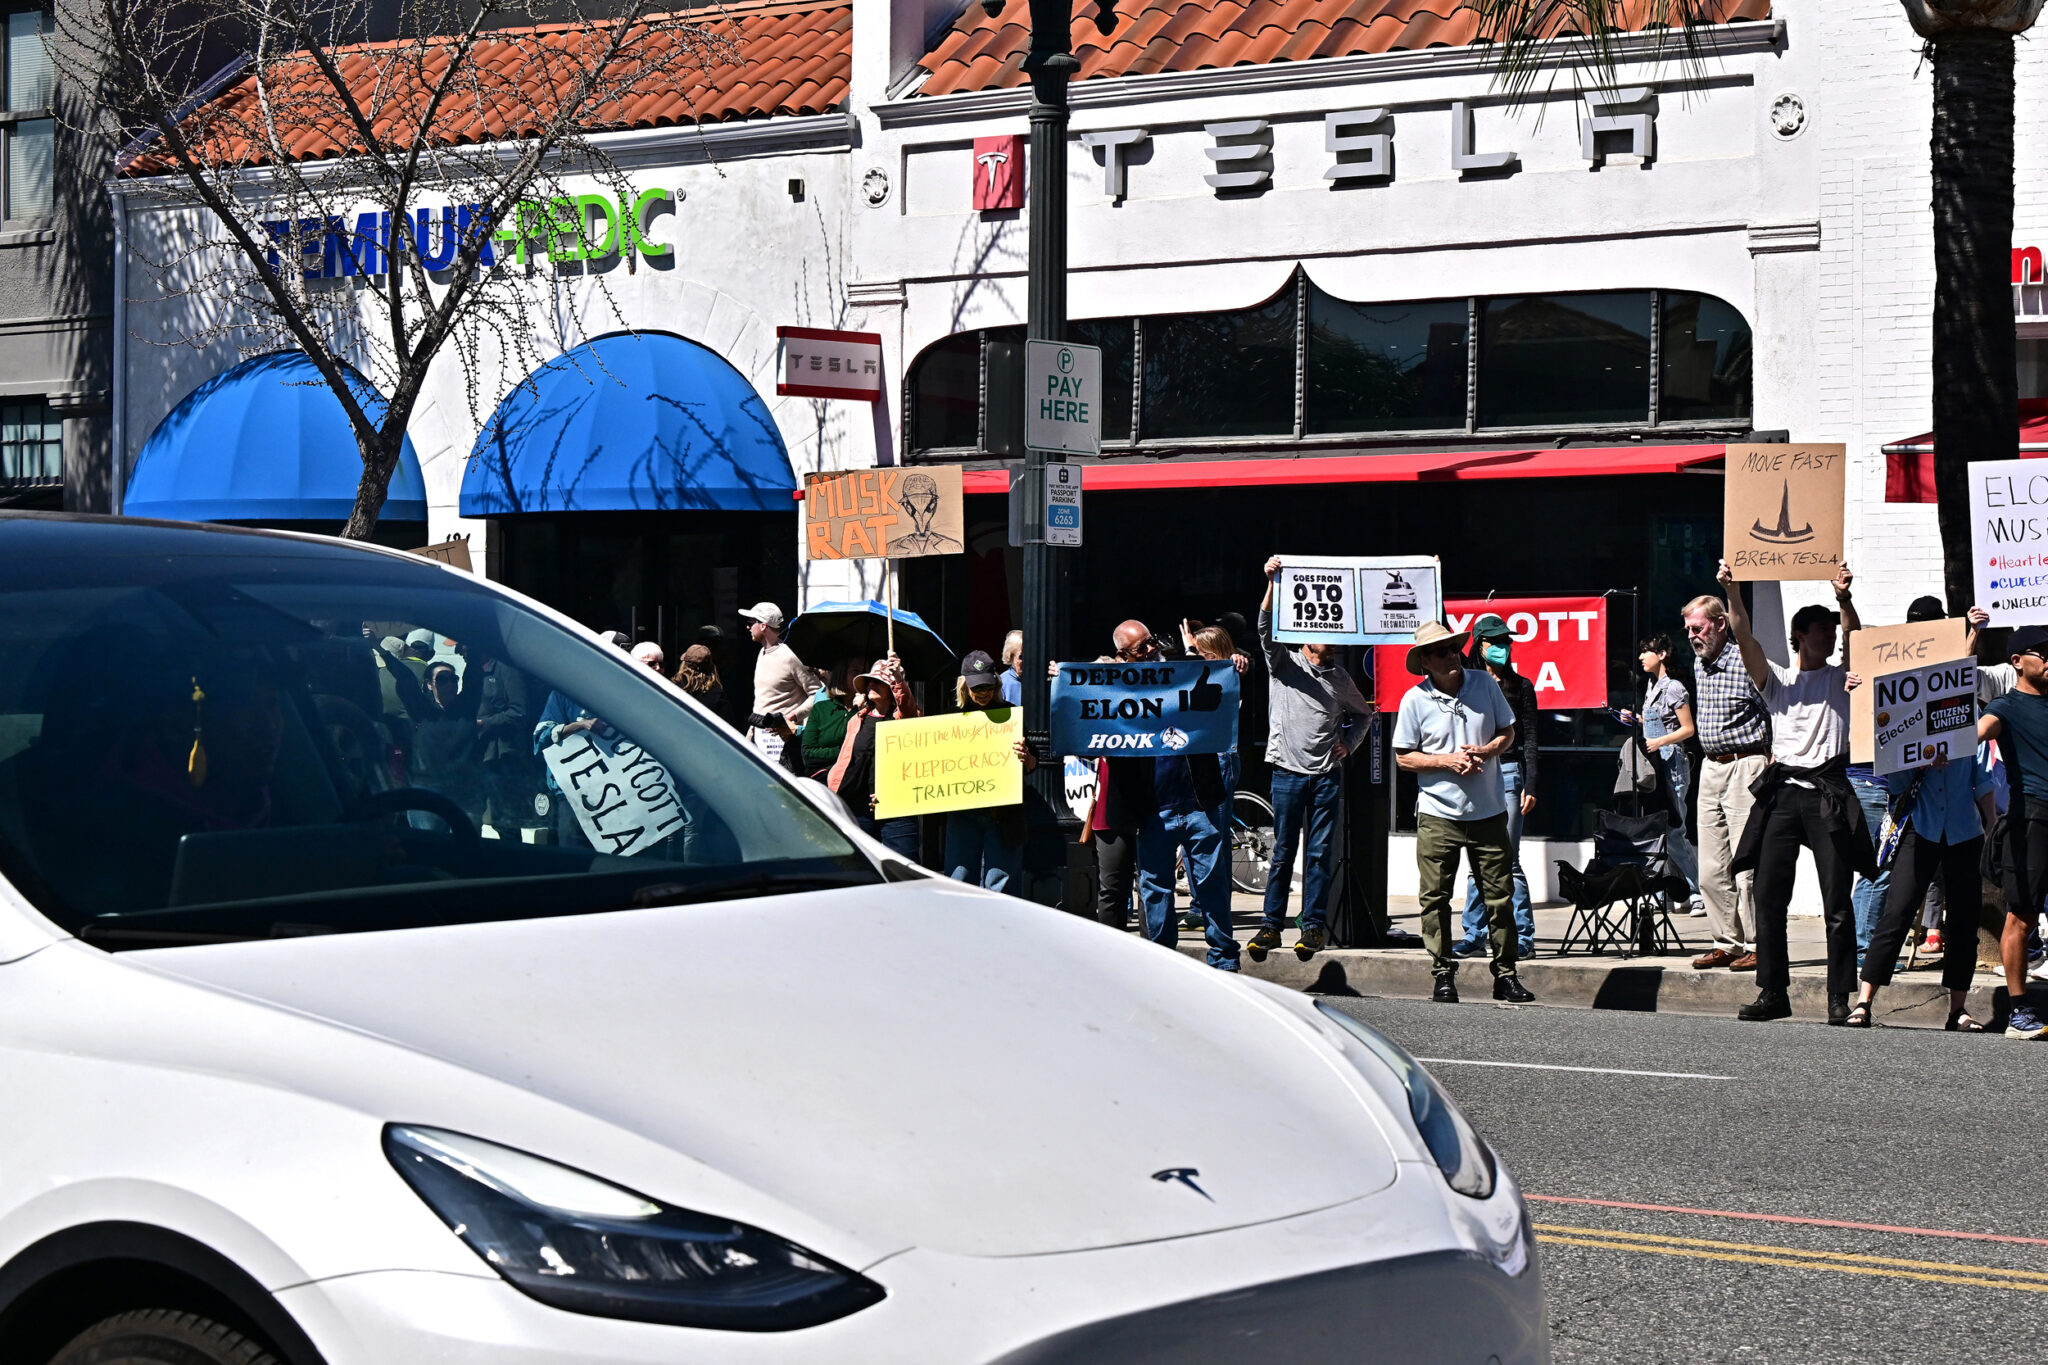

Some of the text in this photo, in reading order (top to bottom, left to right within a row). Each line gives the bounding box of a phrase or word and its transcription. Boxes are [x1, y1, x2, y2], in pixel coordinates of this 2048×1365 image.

[1081, 87, 1655, 196] TESLA
[790, 354, 876, 374] TESLA
[1062, 353, 1071, 369] P
[1048, 375, 1083, 398] PAY
[1040, 399, 1089, 424] HERE
[1741, 452, 1838, 472] MOVE FAST
[809, 471, 900, 519] MUSK
[1050, 489, 1077, 497] PASSPORT
[1052, 496, 1075, 504] PARKING
[1054, 515, 1073, 525] 6263
[806, 514, 898, 560] RAT
[1985, 517, 2048, 544] MUS
[1734, 550, 1839, 567] BREAK TESLA
[1293, 574, 1342, 583] GOES FROM
[1311, 584, 1343, 603] TO
[2002, 595, 2048, 610] UNELEC
[1293, 602, 1343, 622] 1939
[1872, 637, 1935, 664] TAKE
[1069, 667, 1175, 686] DEPORT
[1878, 666, 1973, 707] NO ONE
[1080, 697, 1164, 719] ELON
[1930, 704, 1970, 720] CITIZENS
[1878, 709, 1923, 746] Elected
[1934, 714, 1967, 729] UNITED
[885, 730, 931, 754] FIGHT
[1087, 733, 1155, 749] HONK
[902, 750, 1011, 782] KLEPTOCRACY
[560, 735, 645, 855] TESLA
[912, 779, 996, 804] TRAITORS
